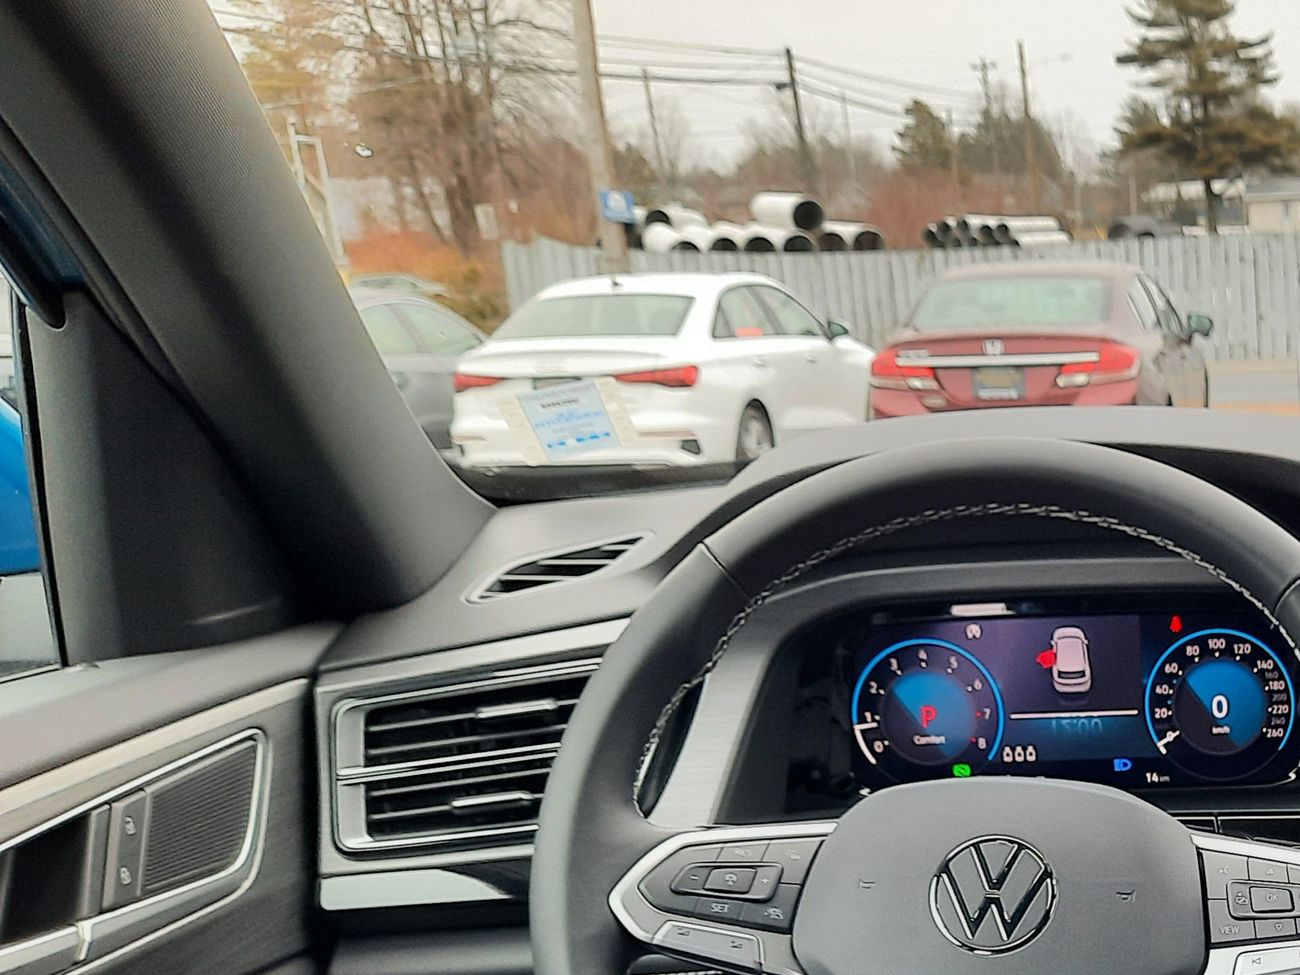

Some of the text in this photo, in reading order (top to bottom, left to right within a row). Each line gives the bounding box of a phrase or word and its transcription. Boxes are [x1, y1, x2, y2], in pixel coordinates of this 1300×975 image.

[1208, 639, 1226, 649] 100
[1233, 643, 1251, 654] 120
[1186, 645, 1199, 656] 80
[1164, 663, 1178, 674] 60
[1155, 685, 1169, 695] 40
[1269, 680, 1285, 691] 180
[1211, 694, 1229, 719] 0
[1272, 704, 1289, 714] 220
[921, 705, 937, 727] P
[1154, 707, 1168, 718] 20
[1146, 772, 1159, 783] 14
[1266, 893, 1279, 901] OK
[710, 902, 730, 914] SET
[1219, 925, 1240, 935] VIEW
